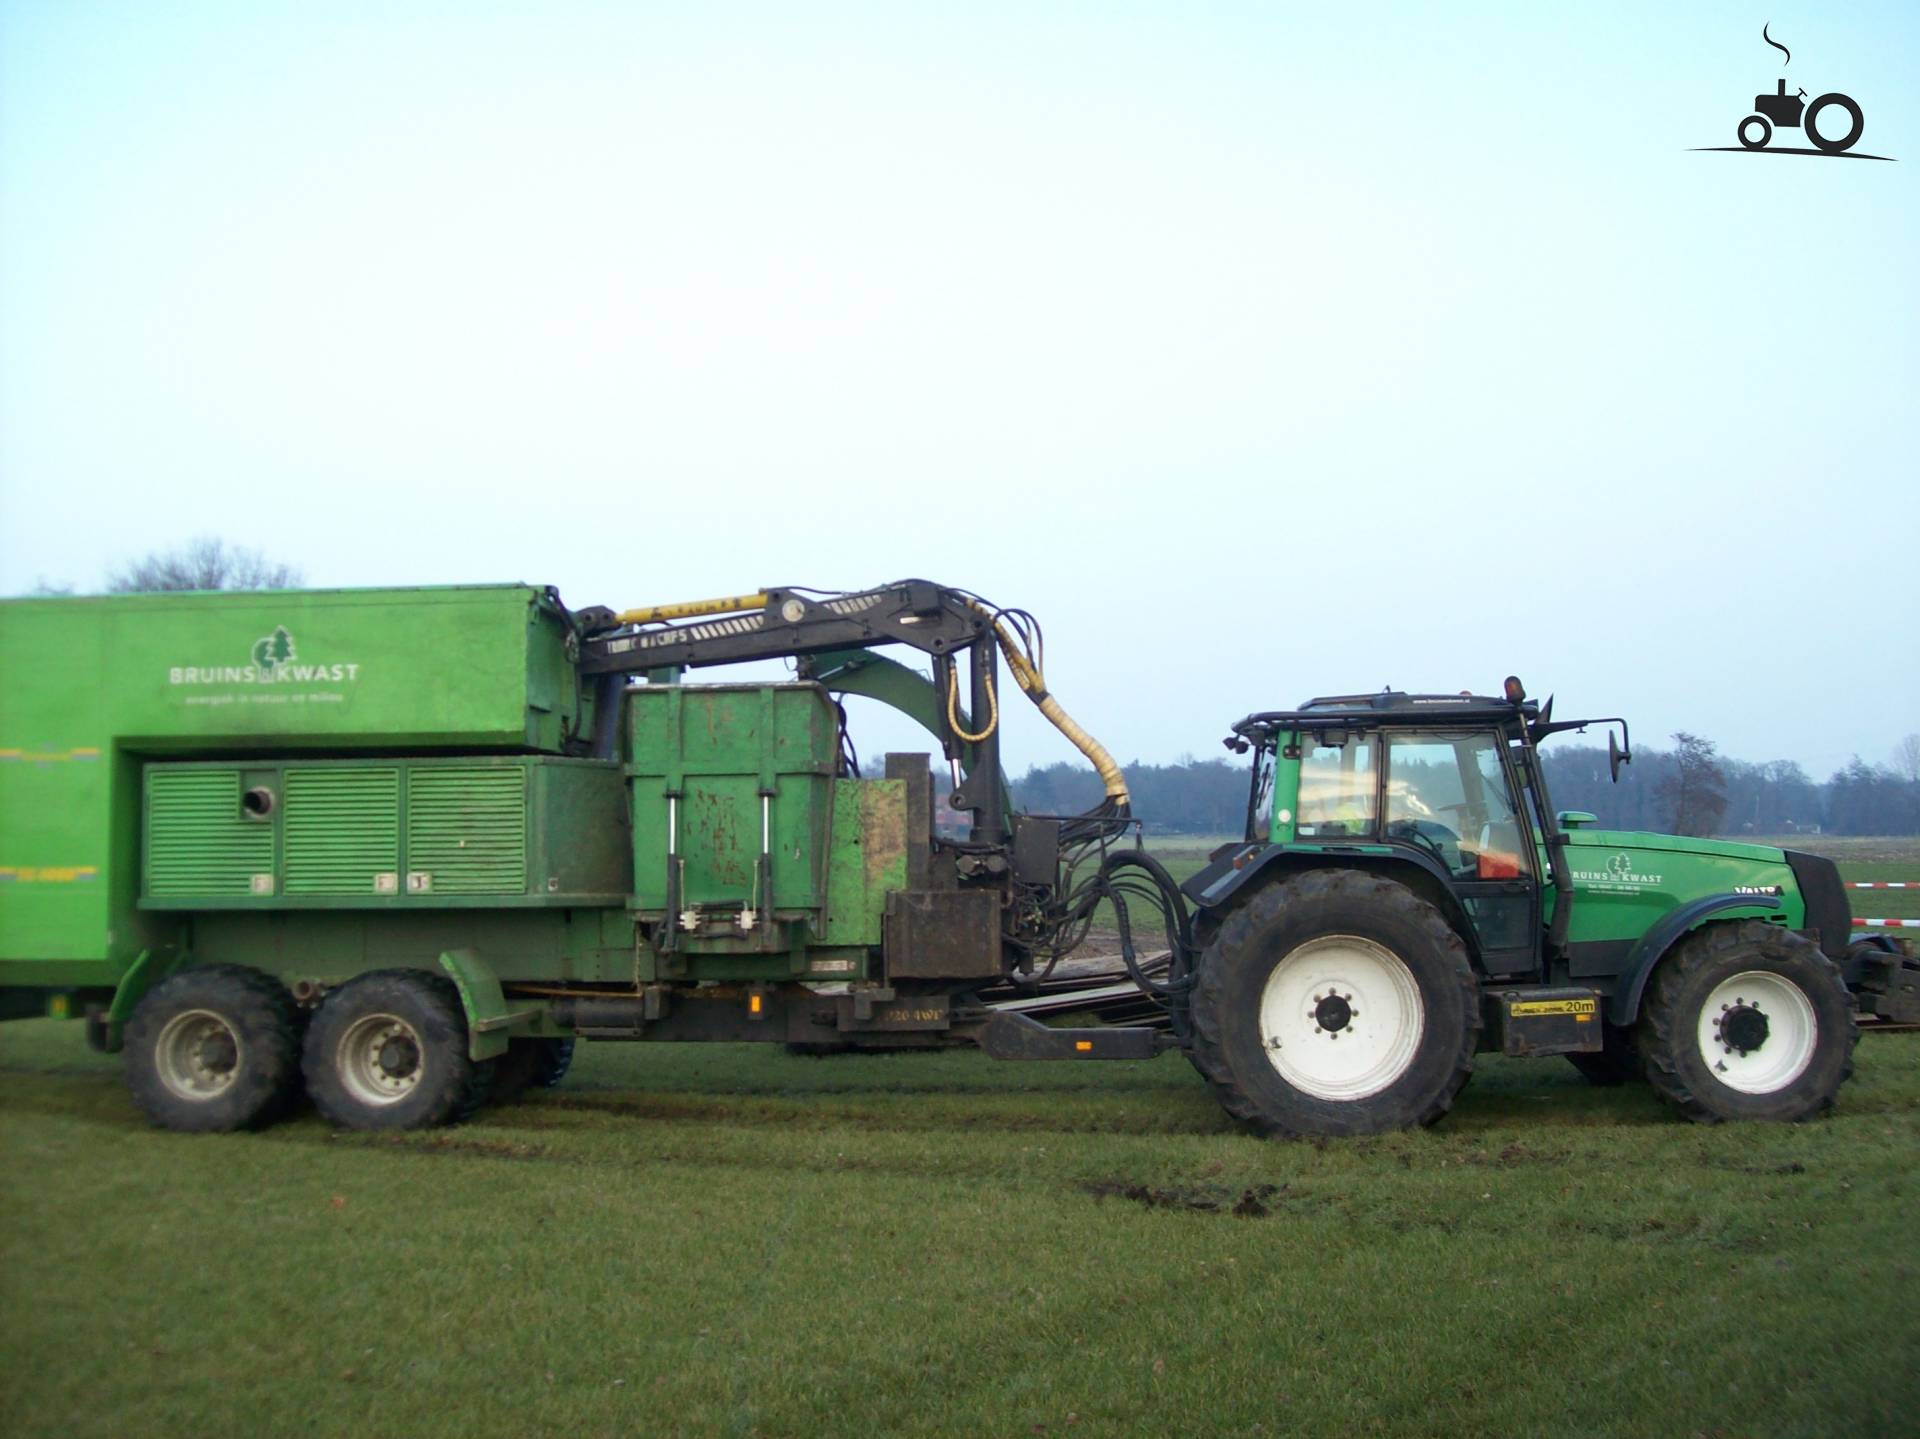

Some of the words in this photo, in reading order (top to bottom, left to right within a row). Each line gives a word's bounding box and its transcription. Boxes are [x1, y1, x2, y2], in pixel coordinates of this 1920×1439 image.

[169, 666, 255, 684] BRUINS
[276, 664, 359, 682] KWAST
[1621, 873, 1662, 883] KWAST
[1733, 885, 1785, 896] VALTRA
[1566, 1001, 1594, 1013] 20m
